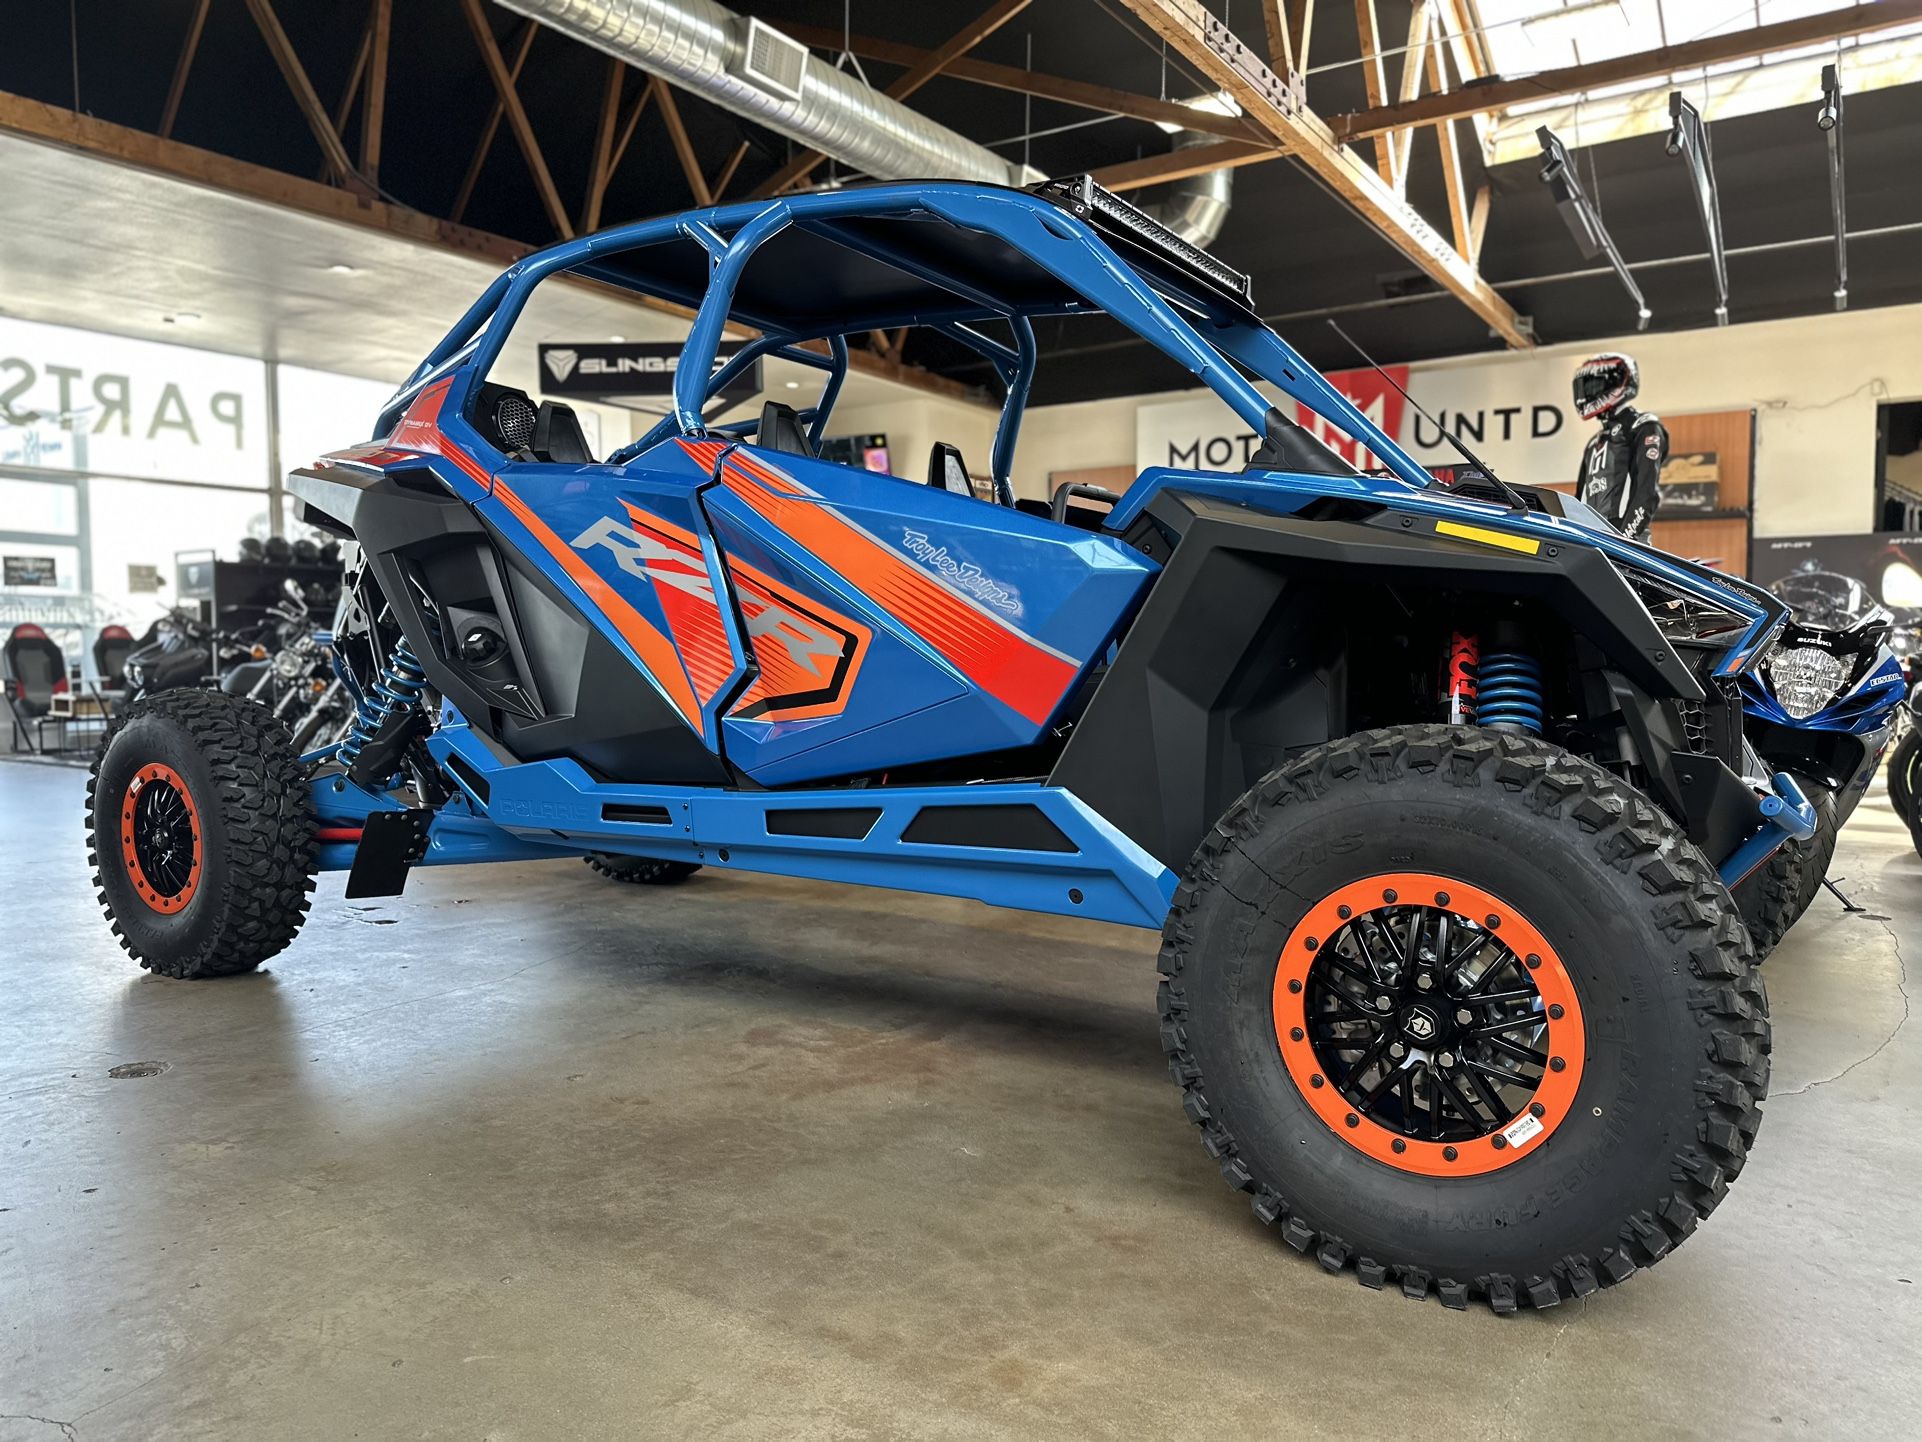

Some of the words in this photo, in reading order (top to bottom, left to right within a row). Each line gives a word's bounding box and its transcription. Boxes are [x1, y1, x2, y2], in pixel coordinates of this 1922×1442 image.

[579, 357, 733, 373] SLINGS
[1169, 434, 1258, 470] MOT
[1414, 404, 1564, 449] UNTD
[902, 530, 936, 562] Troy
[929, 546, 958, 576] Lee
[1797, 637, 1832, 647] SUZUKI
